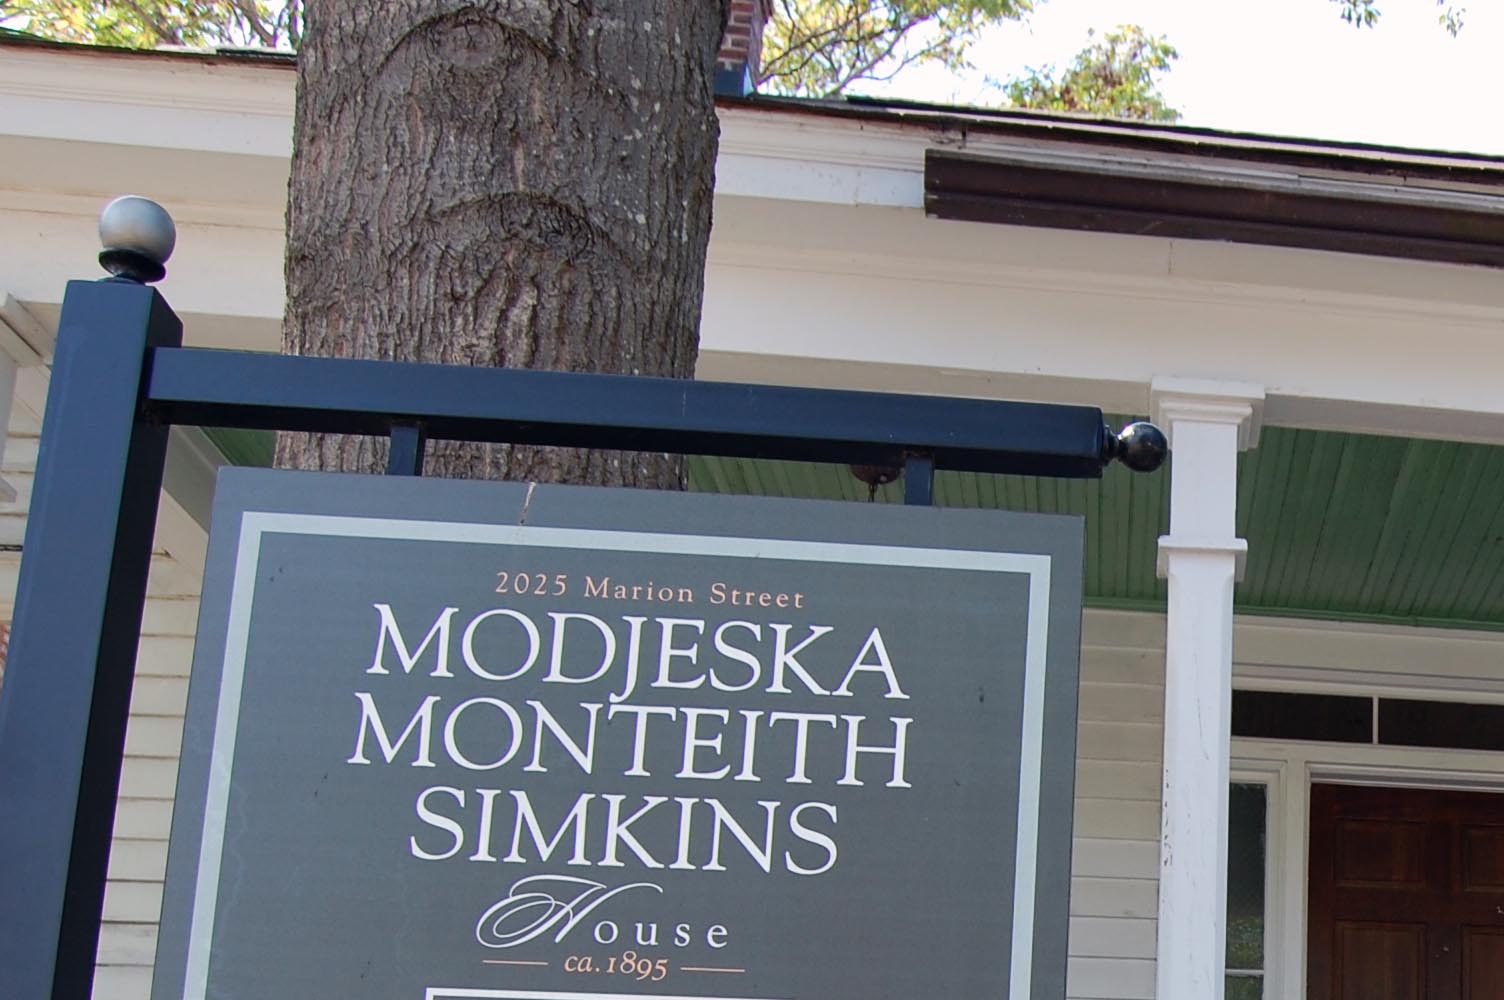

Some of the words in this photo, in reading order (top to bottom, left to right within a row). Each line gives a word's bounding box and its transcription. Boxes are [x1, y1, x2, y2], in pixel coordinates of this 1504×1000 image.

[496, 571, 569, 596] 2025
[584, 576, 695, 604] Marion
[710, 583, 806, 609] Street
[366, 603, 910, 702] MODJESKA
[347, 692, 914, 788] MONTEITH
[410, 786, 838, 875] SIMKINS
[475, 874, 728, 948] House
